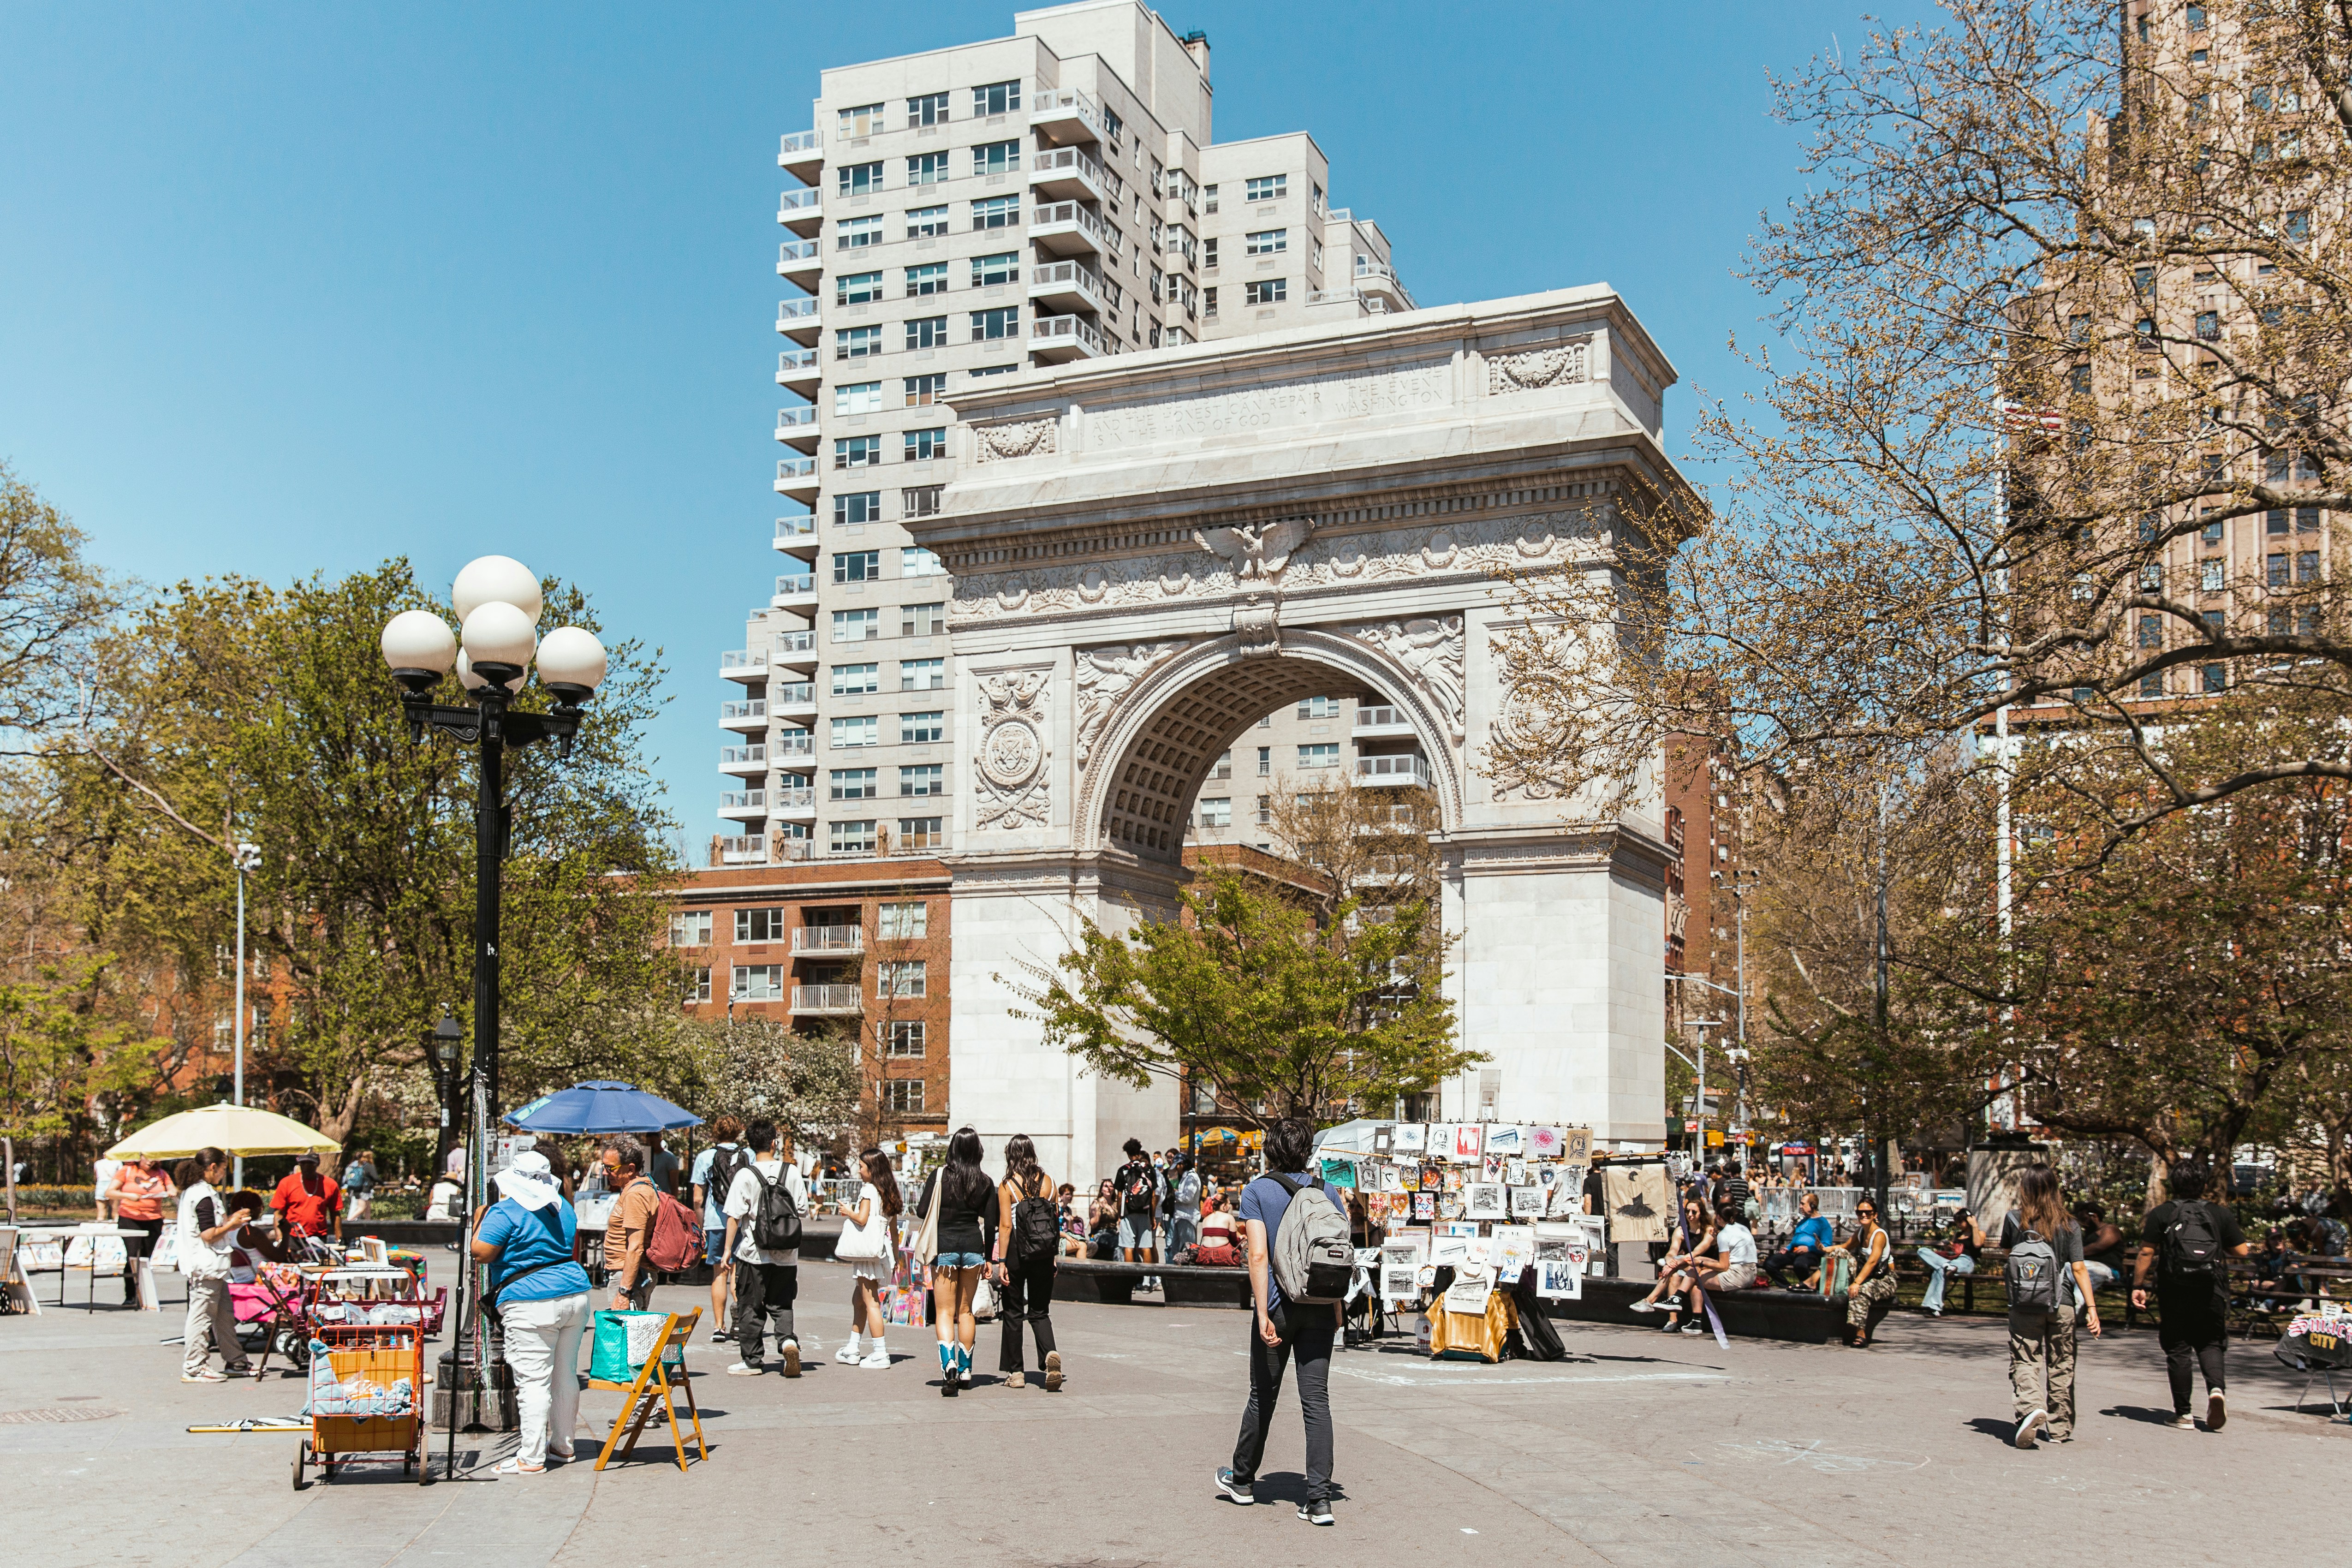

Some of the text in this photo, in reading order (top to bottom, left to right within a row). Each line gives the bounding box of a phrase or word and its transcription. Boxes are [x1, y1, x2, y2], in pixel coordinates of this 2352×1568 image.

[1092, 375, 1442, 433] AND THE HONEST CAN REPAIR THE EVENT
[1093, 389, 1443, 447] IS IN THE HAND OF GOD WASHINGTON
[1094, 407, 1117, 419] LET
[1142, 399, 1182, 412] RAISE
[1187, 397, 1197, 406] A
[1203, 385, 1280, 405] STANDARD
[1287, 381, 1307, 392] TO
[1312, 372, 1363, 389] WHICH
[1369, 367, 1399, 382] THE
[1406, 361, 1442, 376] WISE
[2310, 1333, 2337, 1350] CITY
